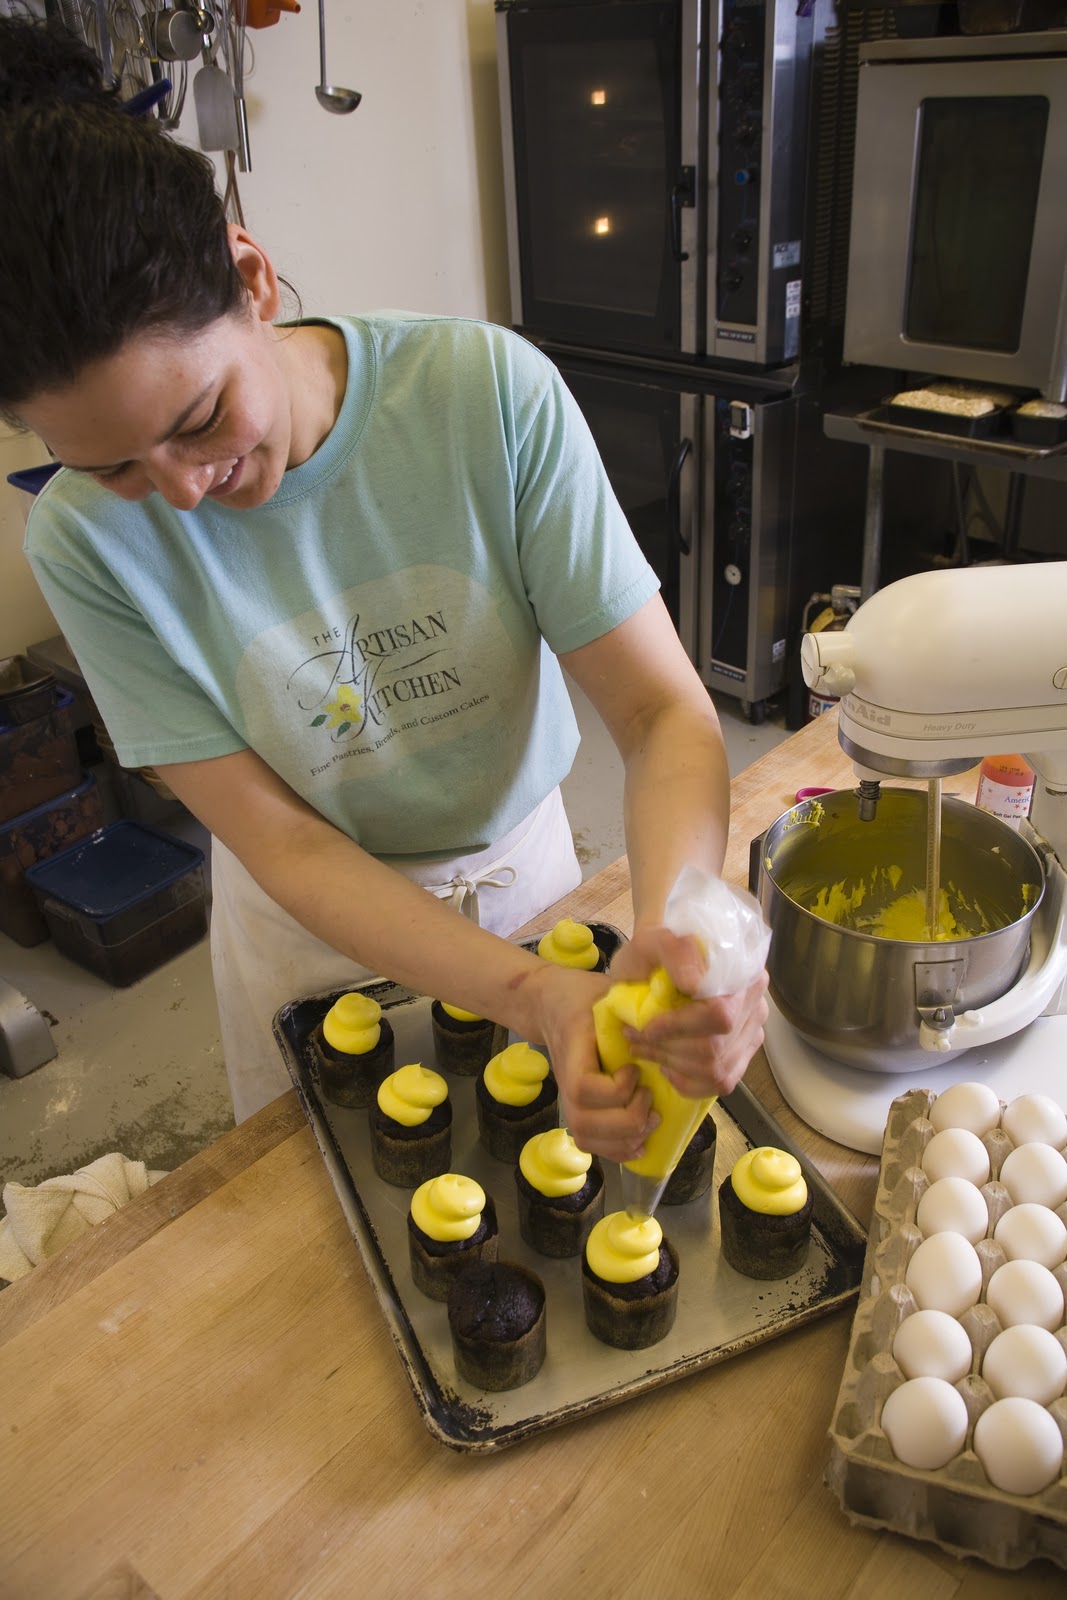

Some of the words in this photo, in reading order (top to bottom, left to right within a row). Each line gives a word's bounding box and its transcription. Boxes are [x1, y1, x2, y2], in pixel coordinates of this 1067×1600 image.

[296, 610, 448, 702] ARTISAN
[313, 627, 341, 647] THE
[310, 761, 331, 777] Fine
[332, 746, 375, 764] Pastries,
[374, 727, 400, 750] Breads,
[401, 718, 419, 730] and
[420, 707, 459, 726] Custom
[460, 694, 490, 712] Cakes
[336, 654, 462, 738] KITCHEN
[923, 723, 953, 733] Heavy
[954, 722, 977, 731] Duty
